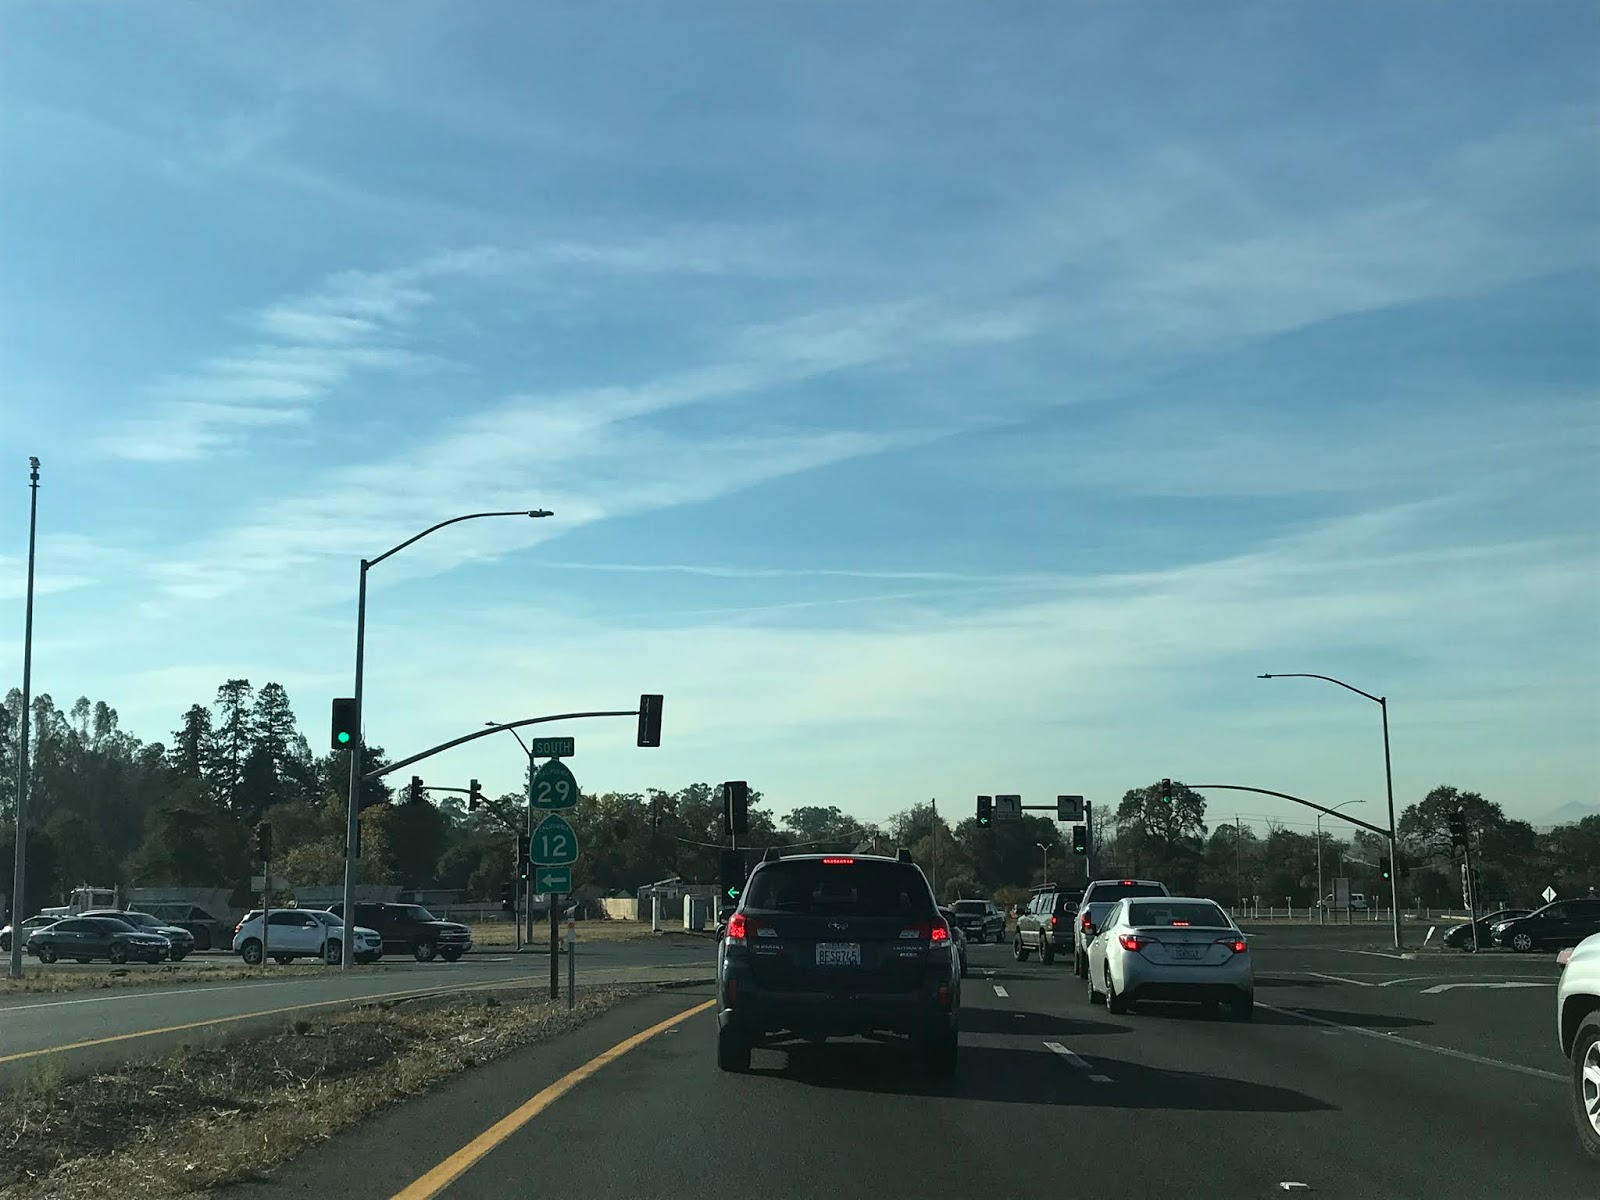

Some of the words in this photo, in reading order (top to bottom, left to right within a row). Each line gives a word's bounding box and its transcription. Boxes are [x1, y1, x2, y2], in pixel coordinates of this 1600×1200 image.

[536, 741, 570, 754] SOUTH
[537, 780, 570, 803] 29
[541, 834, 567, 857] 12
